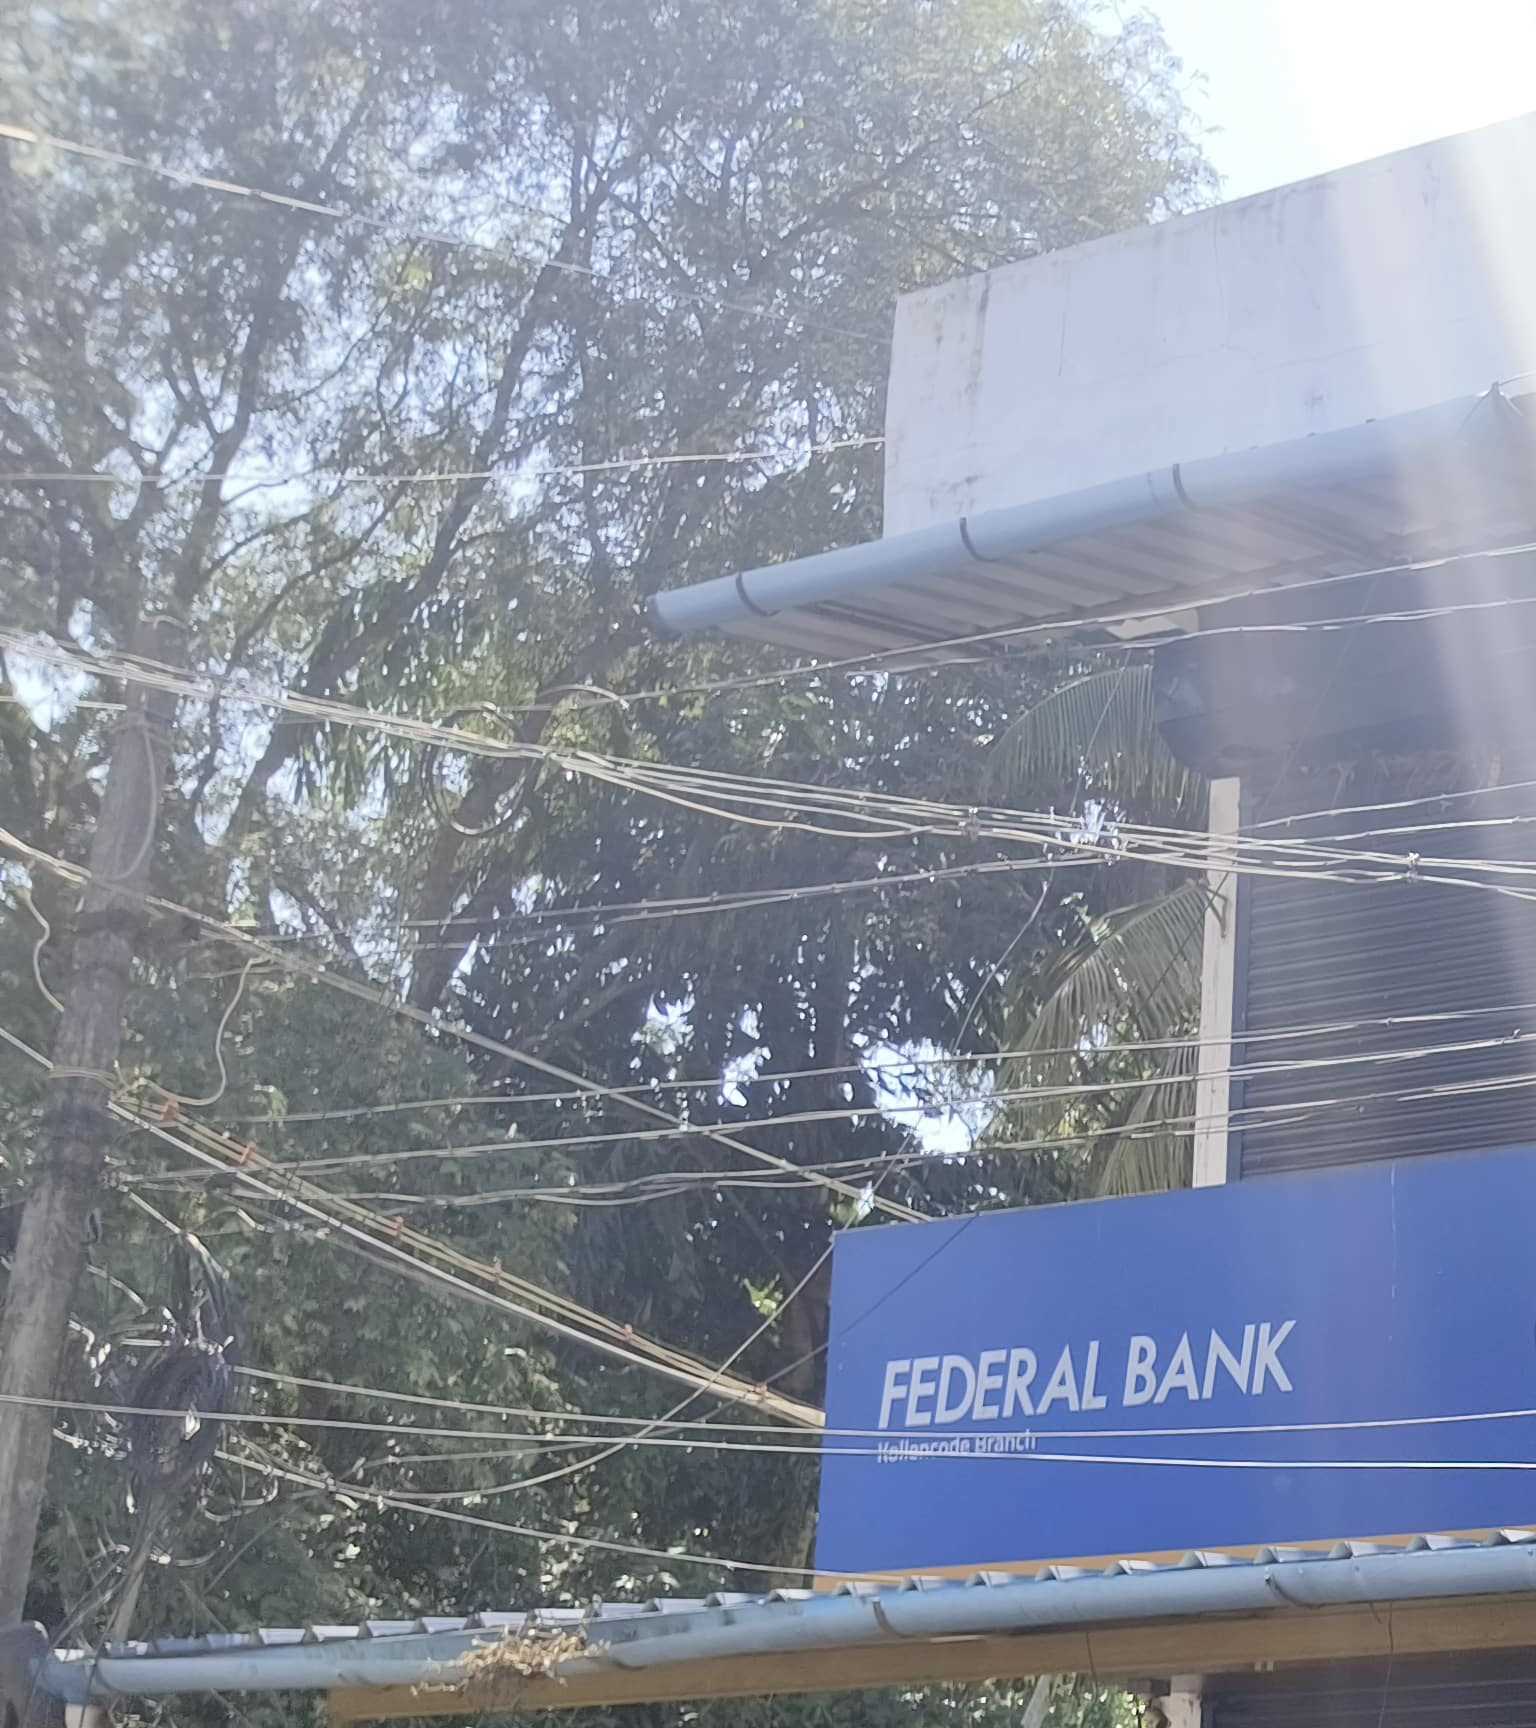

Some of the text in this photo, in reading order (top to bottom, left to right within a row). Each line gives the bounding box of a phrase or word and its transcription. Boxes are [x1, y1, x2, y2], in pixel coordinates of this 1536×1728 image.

[878, 1319, 1297, 1430] FEDERAL BANK
[975, 1429, 1037, 1453] Branch
